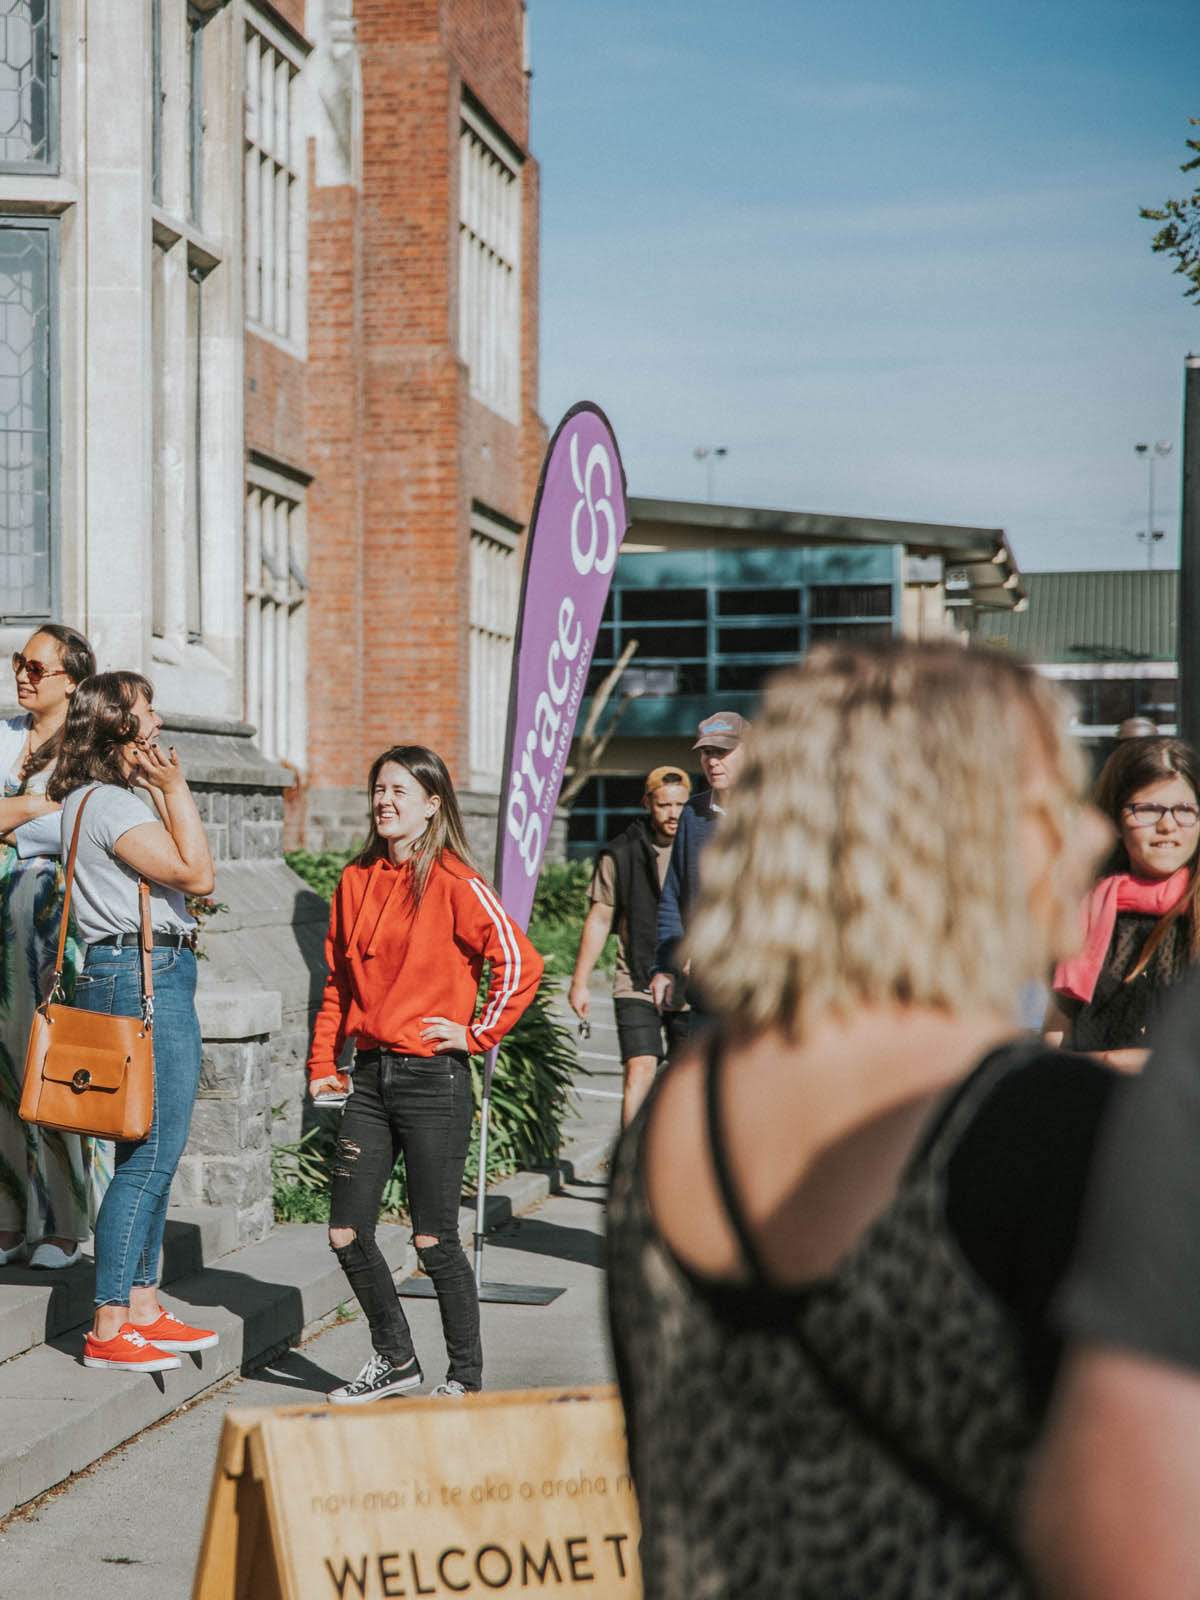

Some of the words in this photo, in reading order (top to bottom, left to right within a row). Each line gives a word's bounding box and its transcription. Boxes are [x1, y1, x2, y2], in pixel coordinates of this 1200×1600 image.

[507, 596, 582, 877] grace
[541, 721, 570, 816] VINEYARD
[566, 638, 592, 719] CHURCH
[542, 1469, 608, 1499] aroha
[324, 1536, 594, 1600] WELCOME
